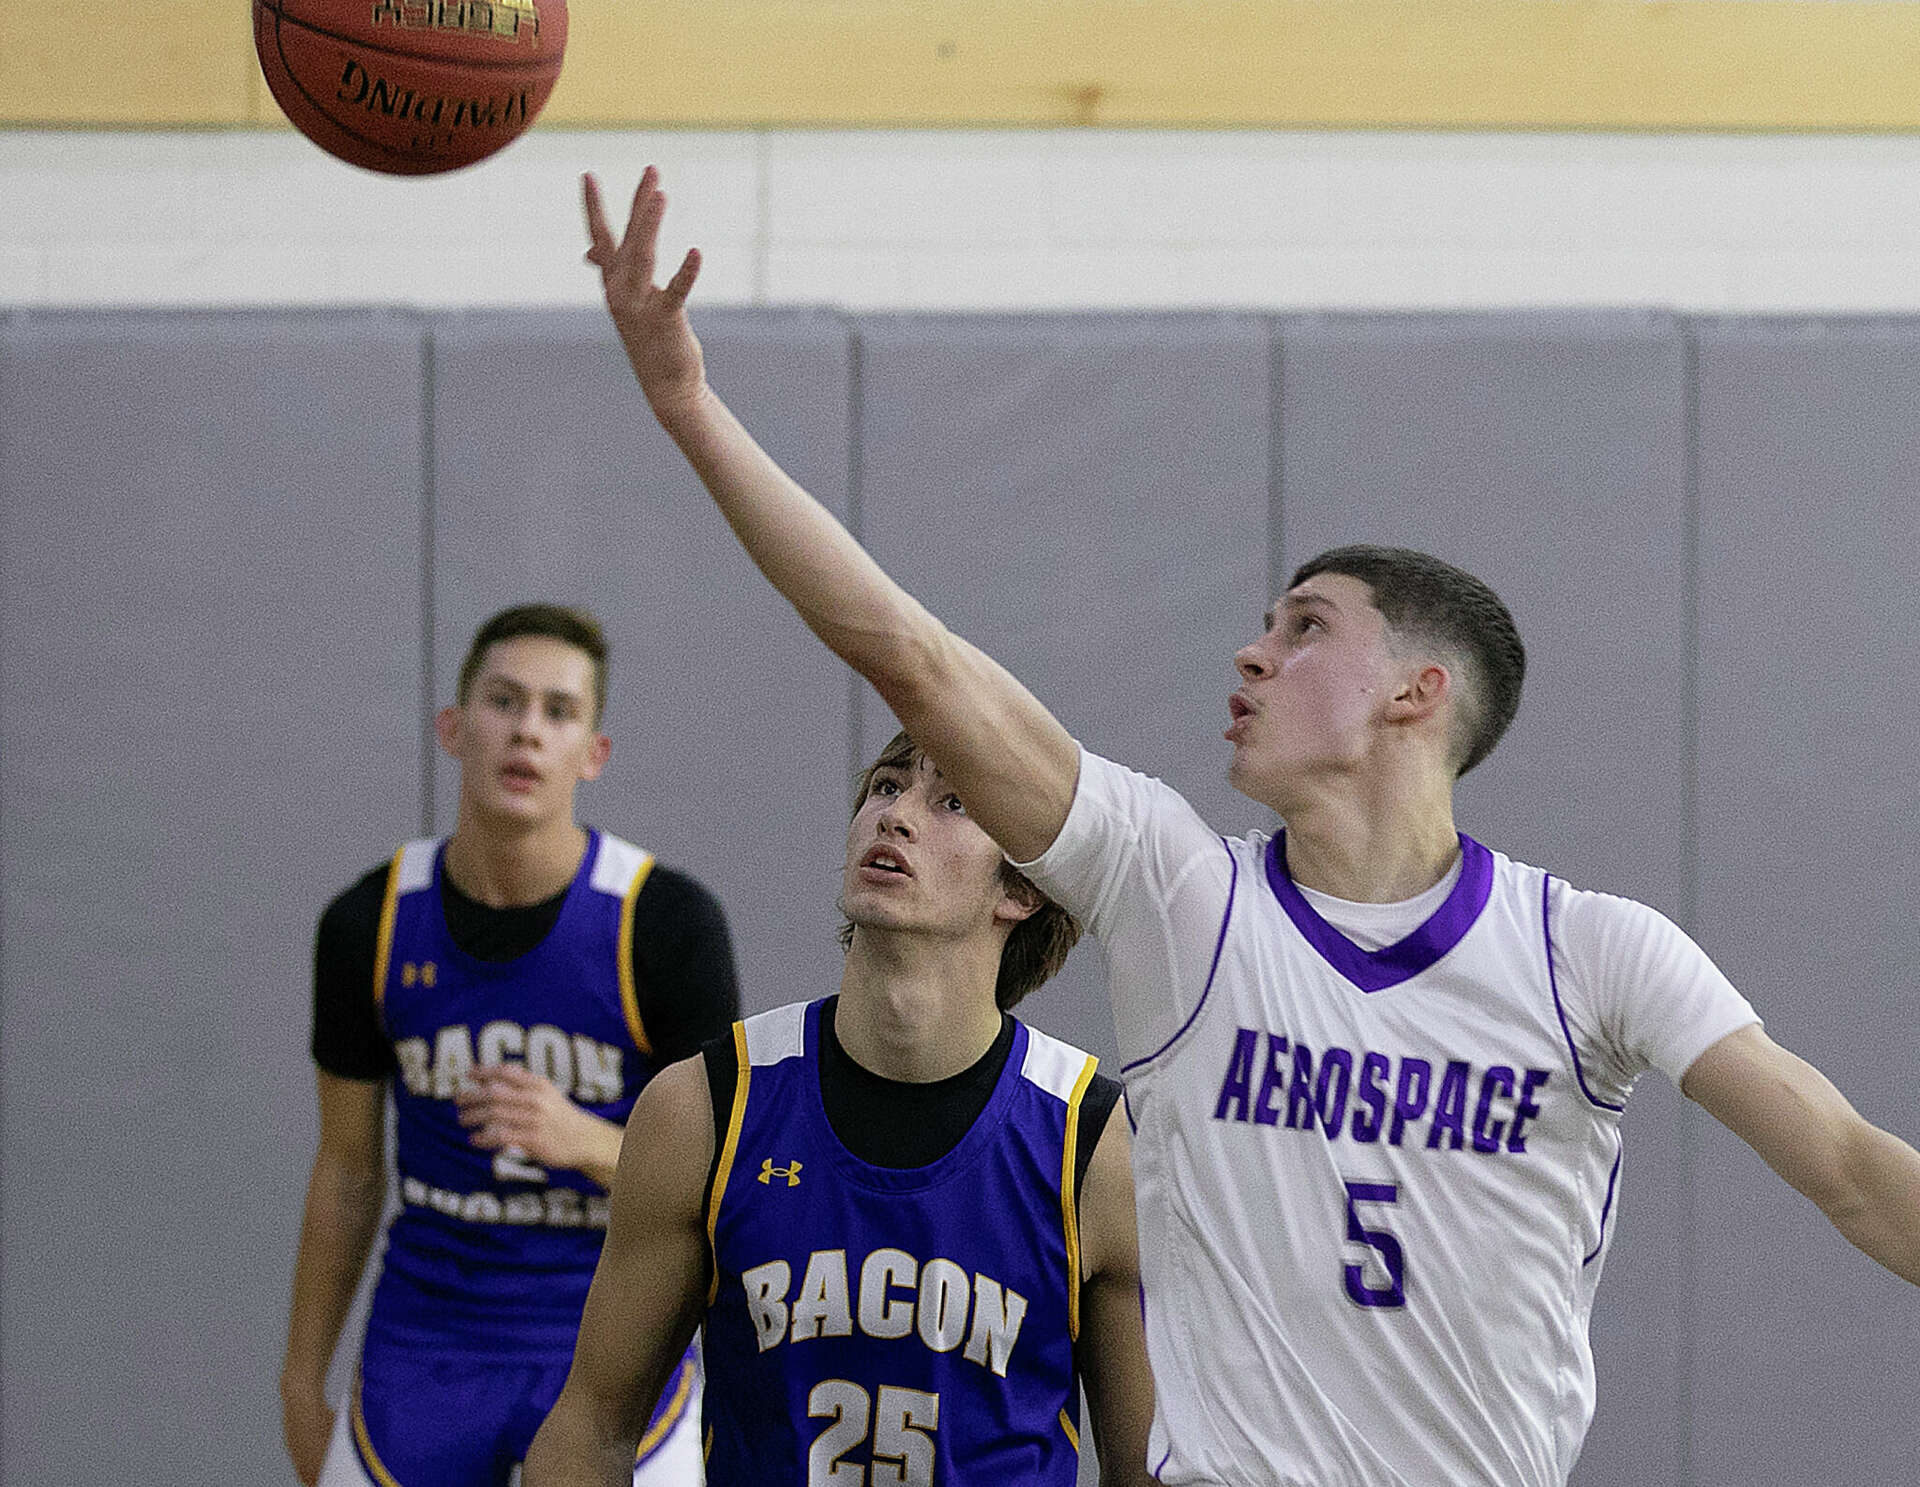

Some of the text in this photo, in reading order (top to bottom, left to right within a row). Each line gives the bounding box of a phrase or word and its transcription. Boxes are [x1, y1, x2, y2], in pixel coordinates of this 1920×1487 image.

[395, 1020, 624, 1102] BACON
[1214, 1028, 1551, 1153] AEROSPACE
[1343, 1179, 1406, 1310] 5
[741, 1247, 1029, 1379] BACON
[807, 1378, 940, 1487] 25
